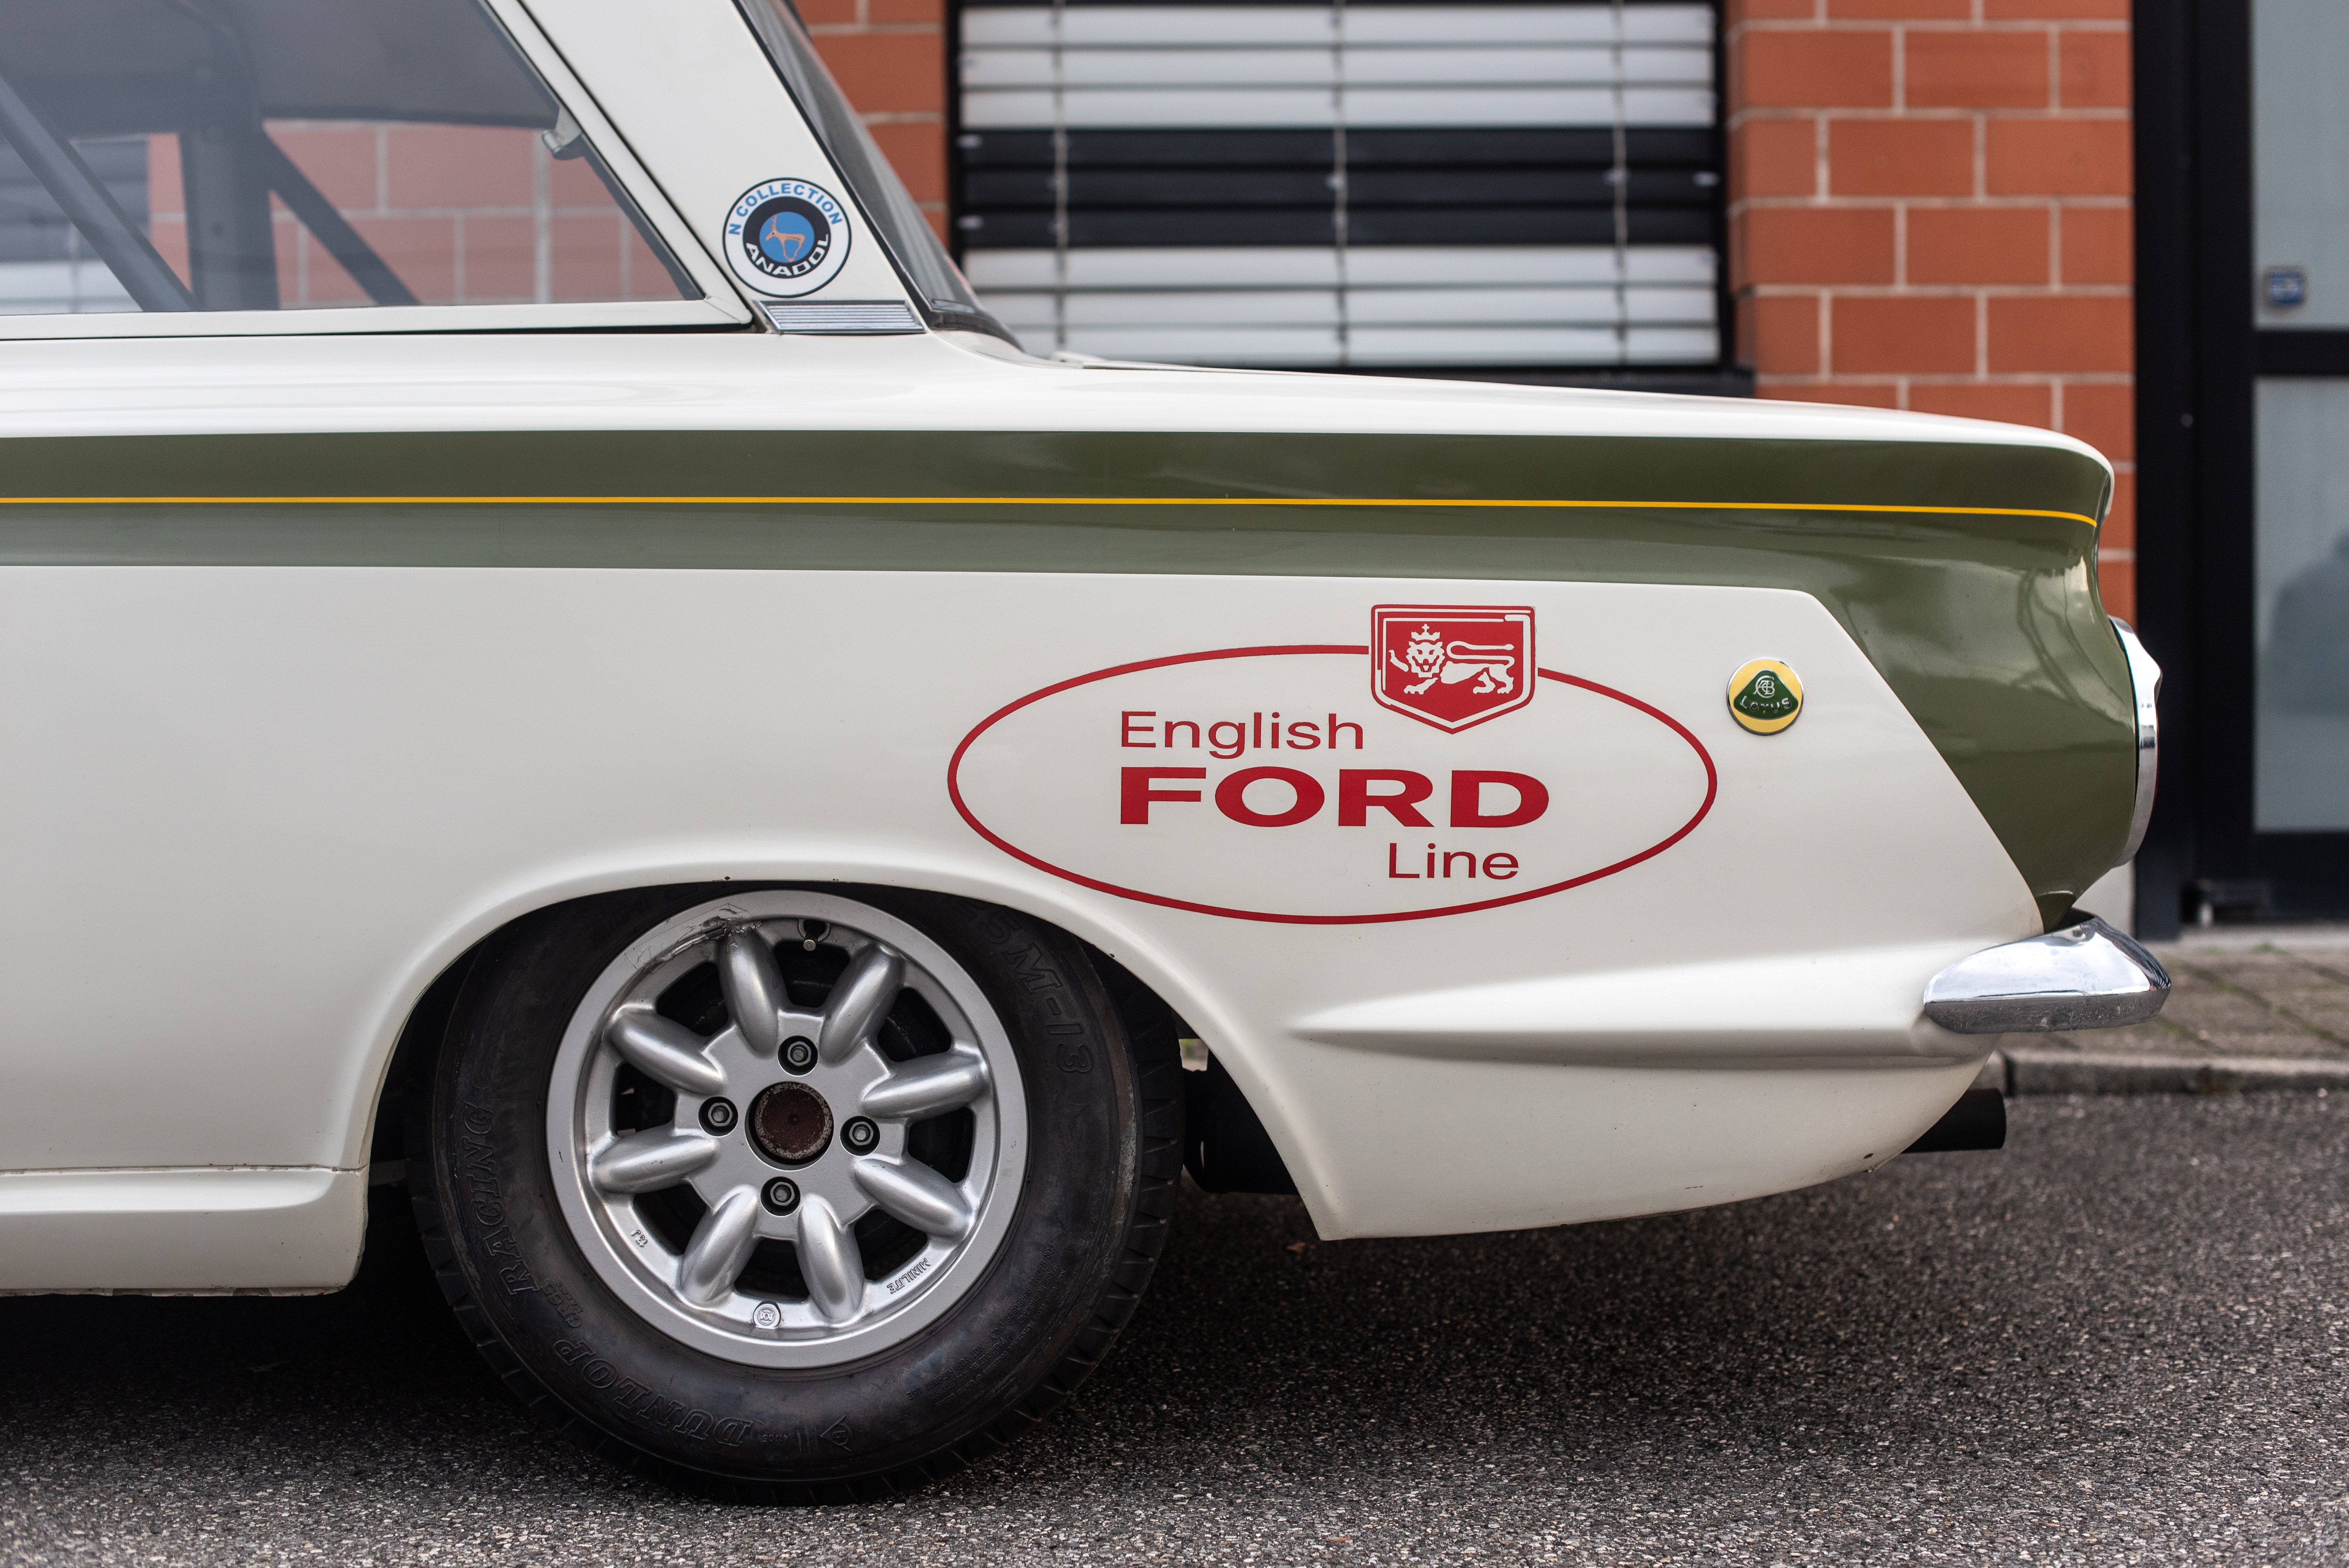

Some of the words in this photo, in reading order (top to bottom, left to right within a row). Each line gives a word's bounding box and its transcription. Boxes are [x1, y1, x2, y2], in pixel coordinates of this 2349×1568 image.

[729, 223, 741, 235] N
[736, 183, 843, 225] COLLECTION
[746, 233, 829, 276] ANADOL
[1739, 695, 1791, 714] LOTUS
[1120, 711, 1364, 759] English
[1119, 766, 1549, 828] FORD
[1388, 843, 1519, 881] Line
[461, 1100, 539, 1295] RACING
[631, 1229, 648, 1247] 13J
[1042, 1242, 1057, 1260] FOR
[886, 1257, 931, 1294] MINILITE
[1027, 1259, 1050, 1288] RACING
[1041, 1263, 1059, 1285] MADE
[1037, 1284, 1047, 1294] IN
[541, 1283, 582, 1328] CR65
[1002, 1286, 1034, 1323] PURPOSES
[1015, 1294, 1041, 1324] ENGLAND
[986, 1321, 1007, 1342] ONLY
[954, 1354, 972, 1371] FOR
[968, 1342, 986, 1359] NOT
[977, 1336, 1007, 1365] FABRIQUE
[922, 1366, 956, 1392] HIGHWAY
[968, 1361, 980, 1372] EN
[553, 1338, 752, 1448] DUNLOP
[905, 1386, 923, 1401] USE
[927, 1368, 971, 1400] ANGLETERRE
